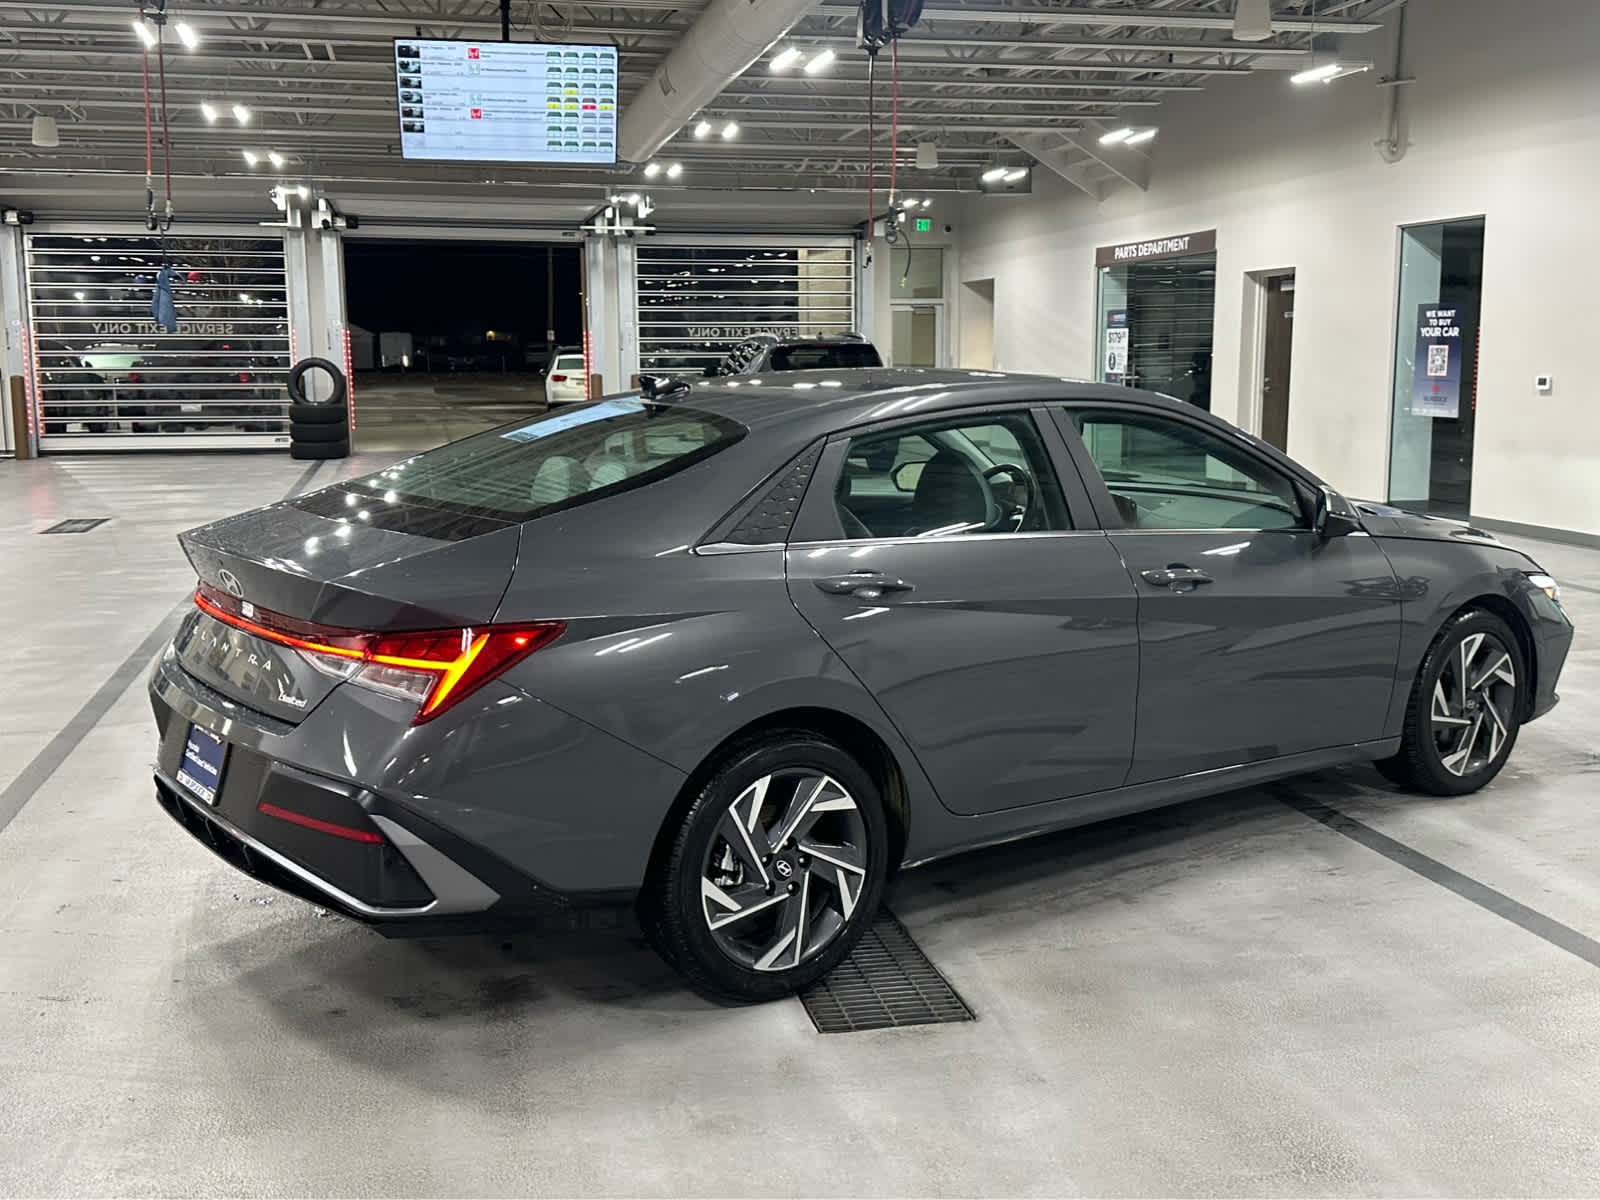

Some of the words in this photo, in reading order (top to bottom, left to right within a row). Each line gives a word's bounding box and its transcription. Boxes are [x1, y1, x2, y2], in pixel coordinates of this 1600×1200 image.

[1114, 245, 1137, 260] PARTS
[1138, 237, 1190, 257] DEPARTMENT
[1425, 310, 1436, 318] WE
[1437, 309, 1456, 318] WANT
[1429, 318, 1438, 326] TO
[1438, 318, 1452, 326] BUY
[1420, 327, 1442, 337] YOUR
[1442, 327, 1460, 337] CAR
[192, 625, 272, 671] ELANTRA
